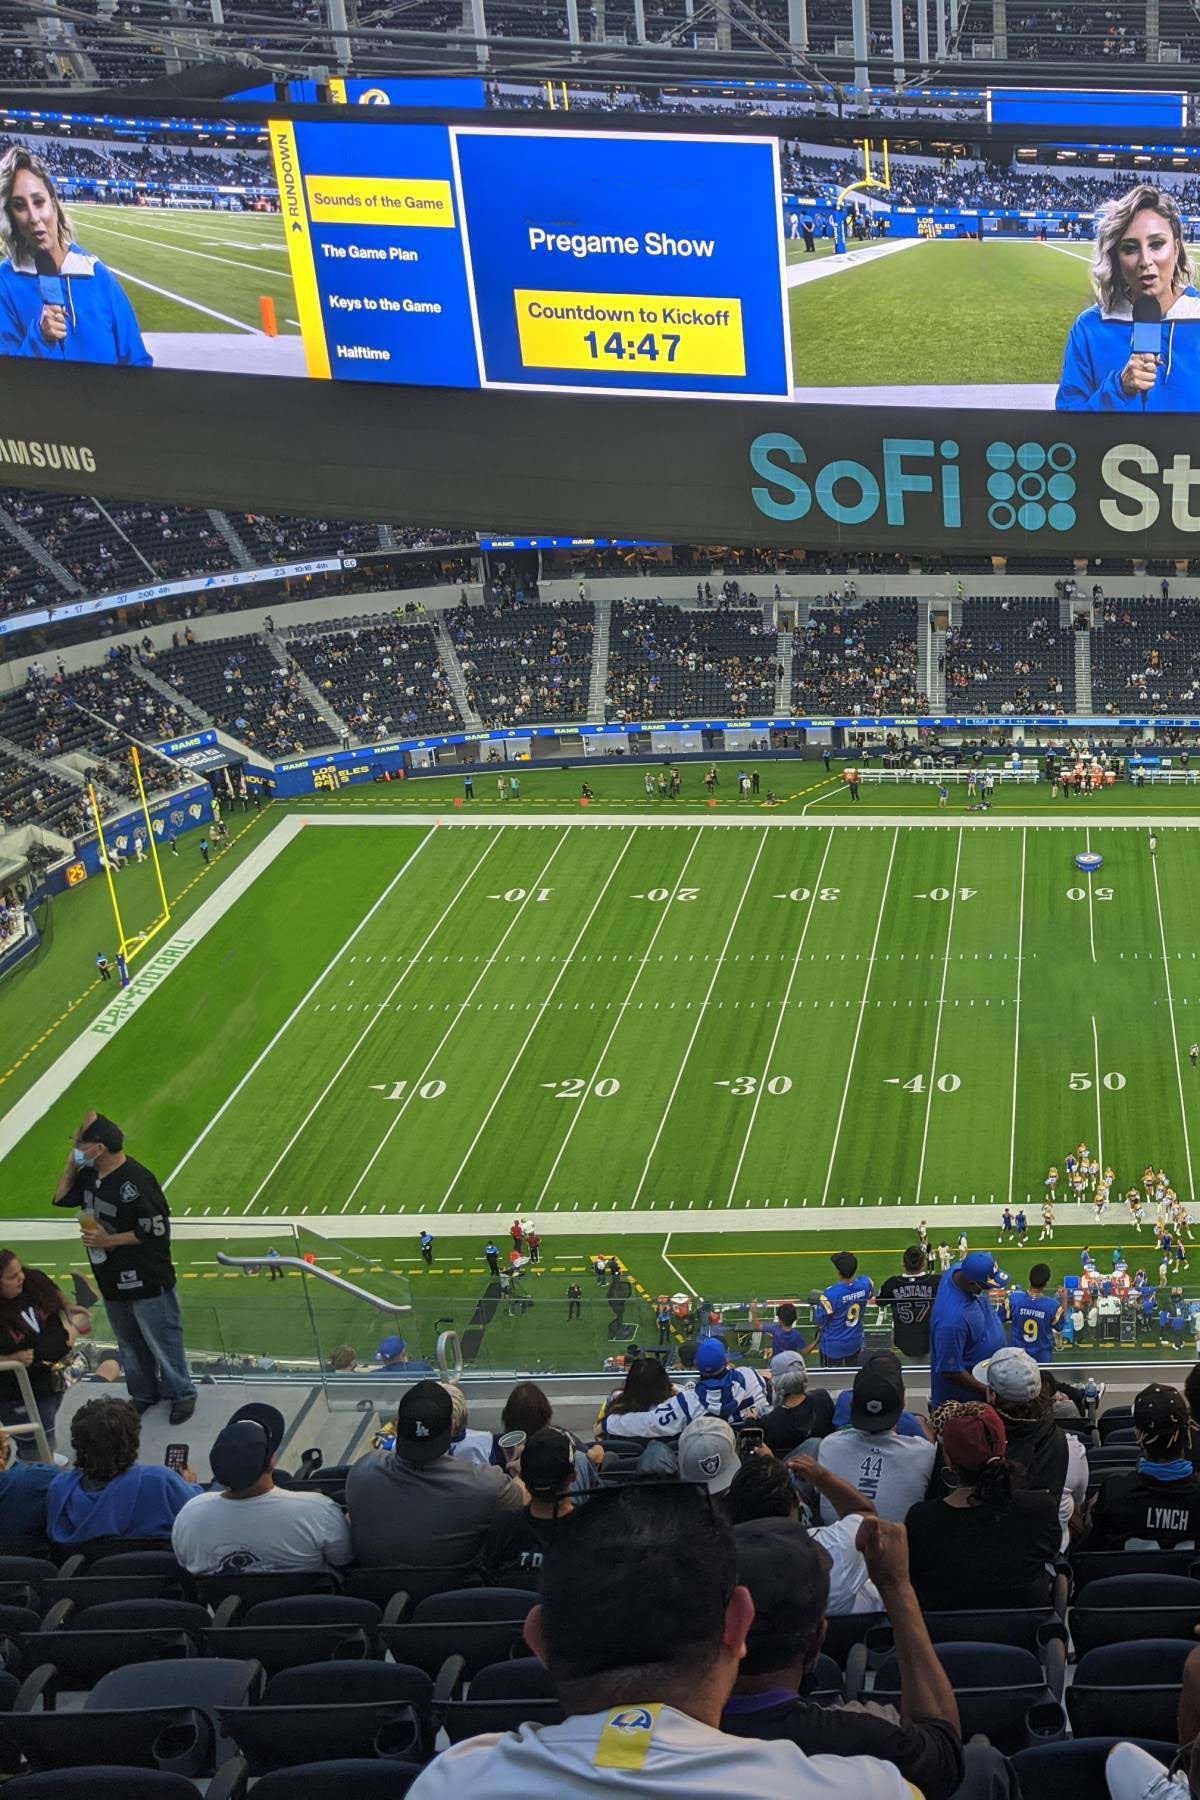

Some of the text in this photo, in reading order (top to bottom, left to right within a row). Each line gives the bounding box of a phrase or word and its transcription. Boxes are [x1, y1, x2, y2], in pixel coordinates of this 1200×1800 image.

[277, 133, 300, 217] RUNDOWN
[314, 192, 444, 210] Sounds of the Game
[321, 243, 419, 262] The Game Plan
[528, 227, 715, 258] Pregame Show
[329, 295, 442, 314] Keys to the Game
[528, 301, 730, 326] Countdown to Kickoff
[336, 344, 391, 361] Halftime
[583, 330, 681, 362] 14:47
[0, 438, 97, 472] AMSUNG
[748, 432, 962, 528] SoFi
[232, 575, 239, 583] 6
[273, 568, 287, 576] 23
[171, 737, 202, 752] RAMS
[282, 760, 309, 771] RAMS
[373, 744, 400, 754] RAMS
[464, 733, 490, 741] RAMS
[554, 727, 579, 735] RAMS
[727, 720, 752, 728] RAMS
[183, 753, 226, 768] Stadium
[312, 765, 337, 776] LOS
[313, 765, 370, 783] ANELES
[504, 886, 556, 902] 10
[647, 886, 701, 902] 20
[788, 886, 841, 901] 30
[929, 887, 979, 901] 40
[1066, 887, 1115, 901] 50
[133, 938, 195, 996] FOOTBALL
[383, 1079, 447, 1100] 10
[554, 1078, 620, 1098] 20
[729, 1075, 793, 1096] 30
[902, 1072, 962, 1093] 40
[1069, 1071, 1127, 1091] 50
[138, 1214, 167, 1237] 75
[842, 1290, 866, 1302] STAFFORD
[846, 1303, 861, 1328] 9
[896, 1301, 931, 1325] 57
[1019, 1307, 1046, 1319] STAFFORD
[1023, 1319, 1039, 1343] 9
[655, 1402, 678, 1427] 75
[415, 1420, 430, 1438] LA
[860, 1456, 884, 1478] 44
[1146, 1505, 1190, 1532] LYNCH
